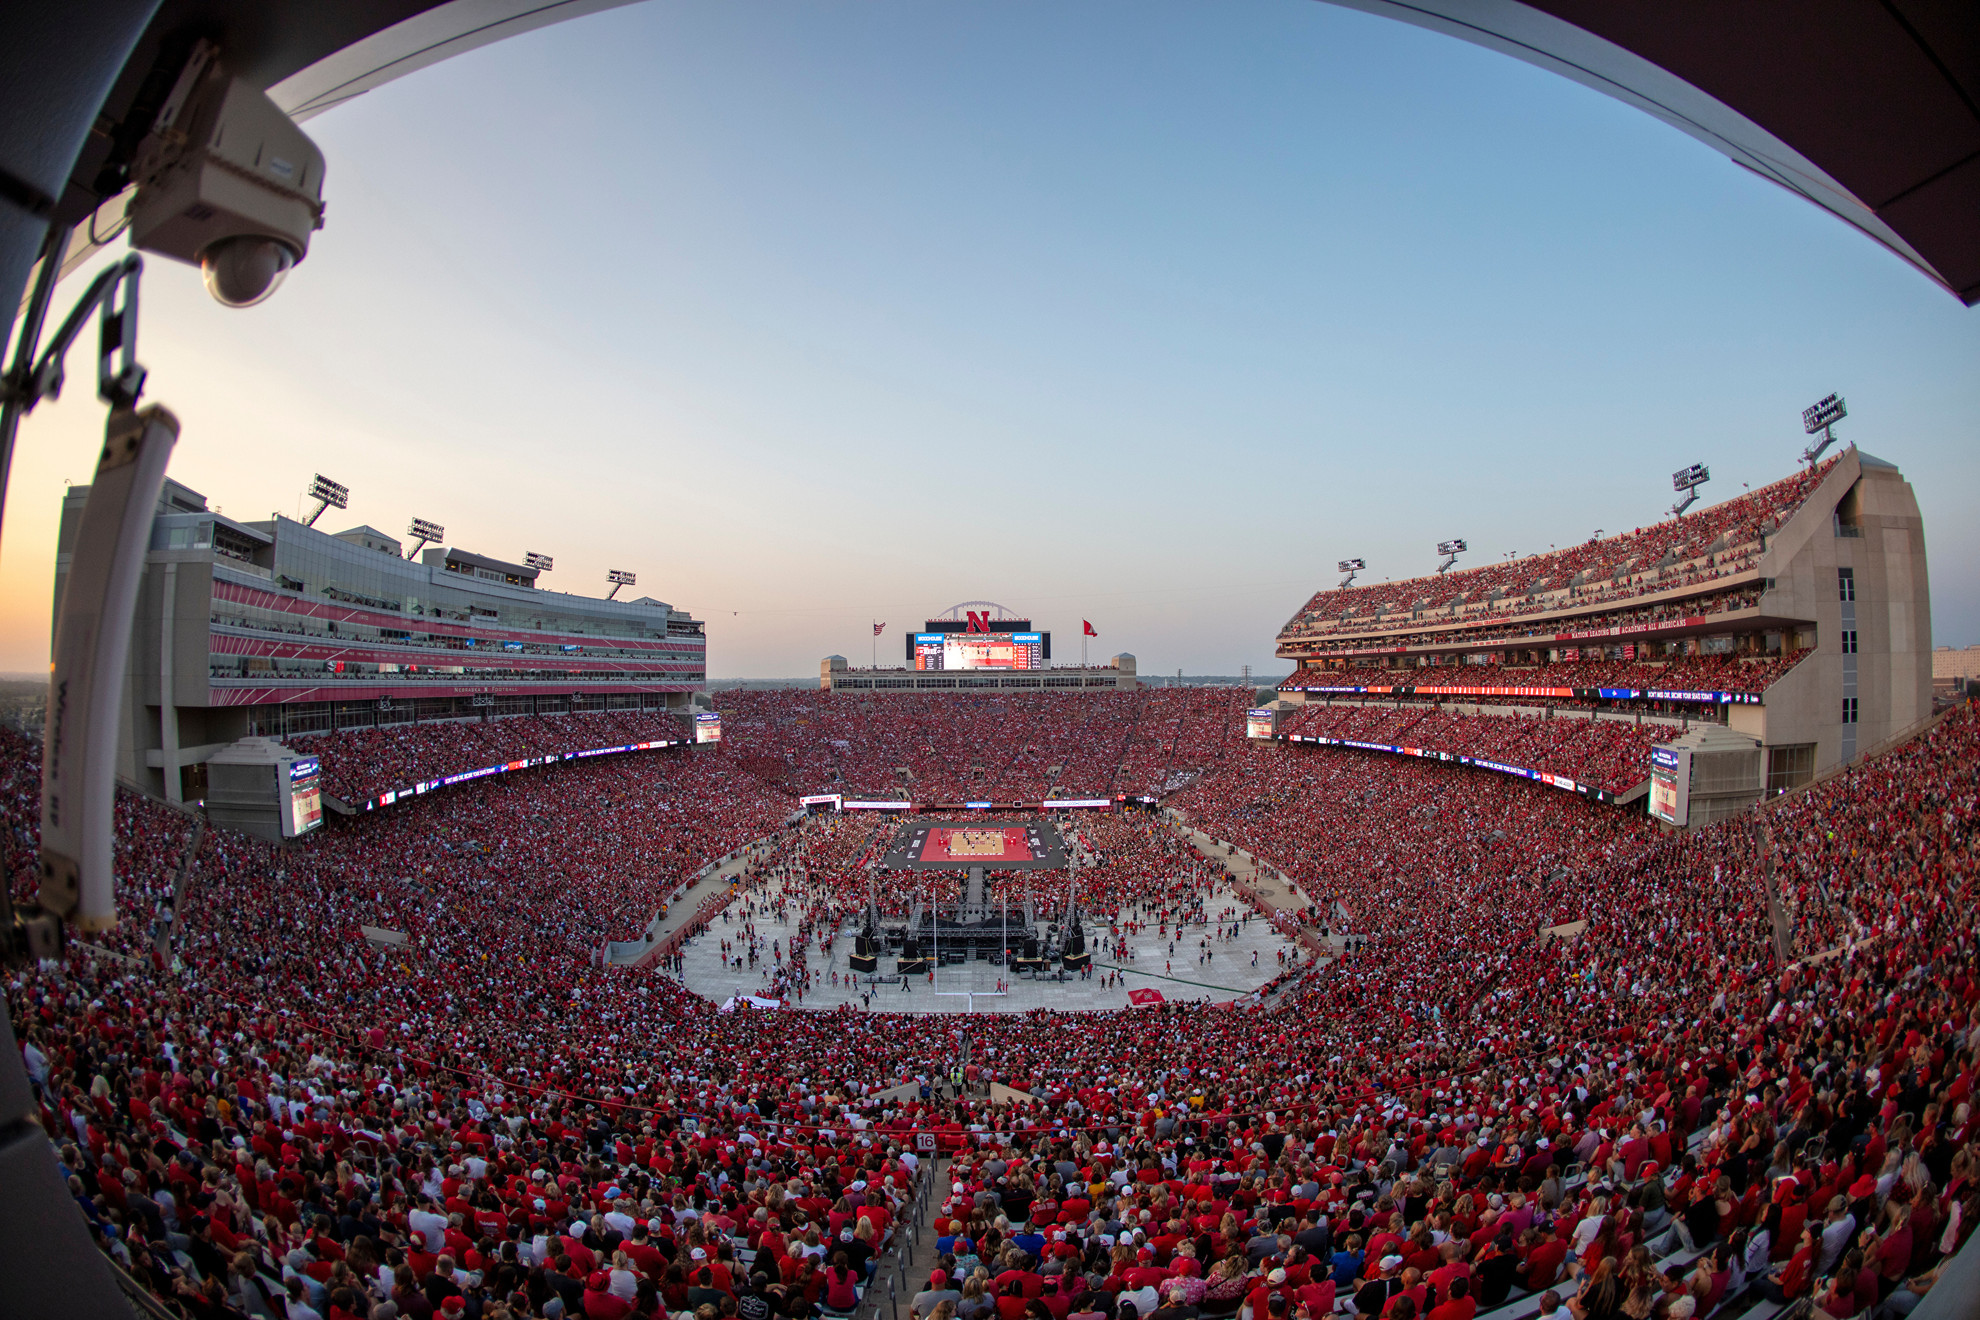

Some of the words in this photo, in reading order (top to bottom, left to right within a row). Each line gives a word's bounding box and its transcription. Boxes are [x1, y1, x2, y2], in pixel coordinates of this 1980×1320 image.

[966, 611, 990, 632] N
[1621, 625, 1646, 634] ACADEMIC
[1648, 623, 1657, 631] ALL
[1658, 619, 1687, 629] AMERICANS
[1590, 629, 1609, 637] LEADING
[1515, 687, 1556, 695] NEBRASKA
[919, 1135, 934, 1147] 16
